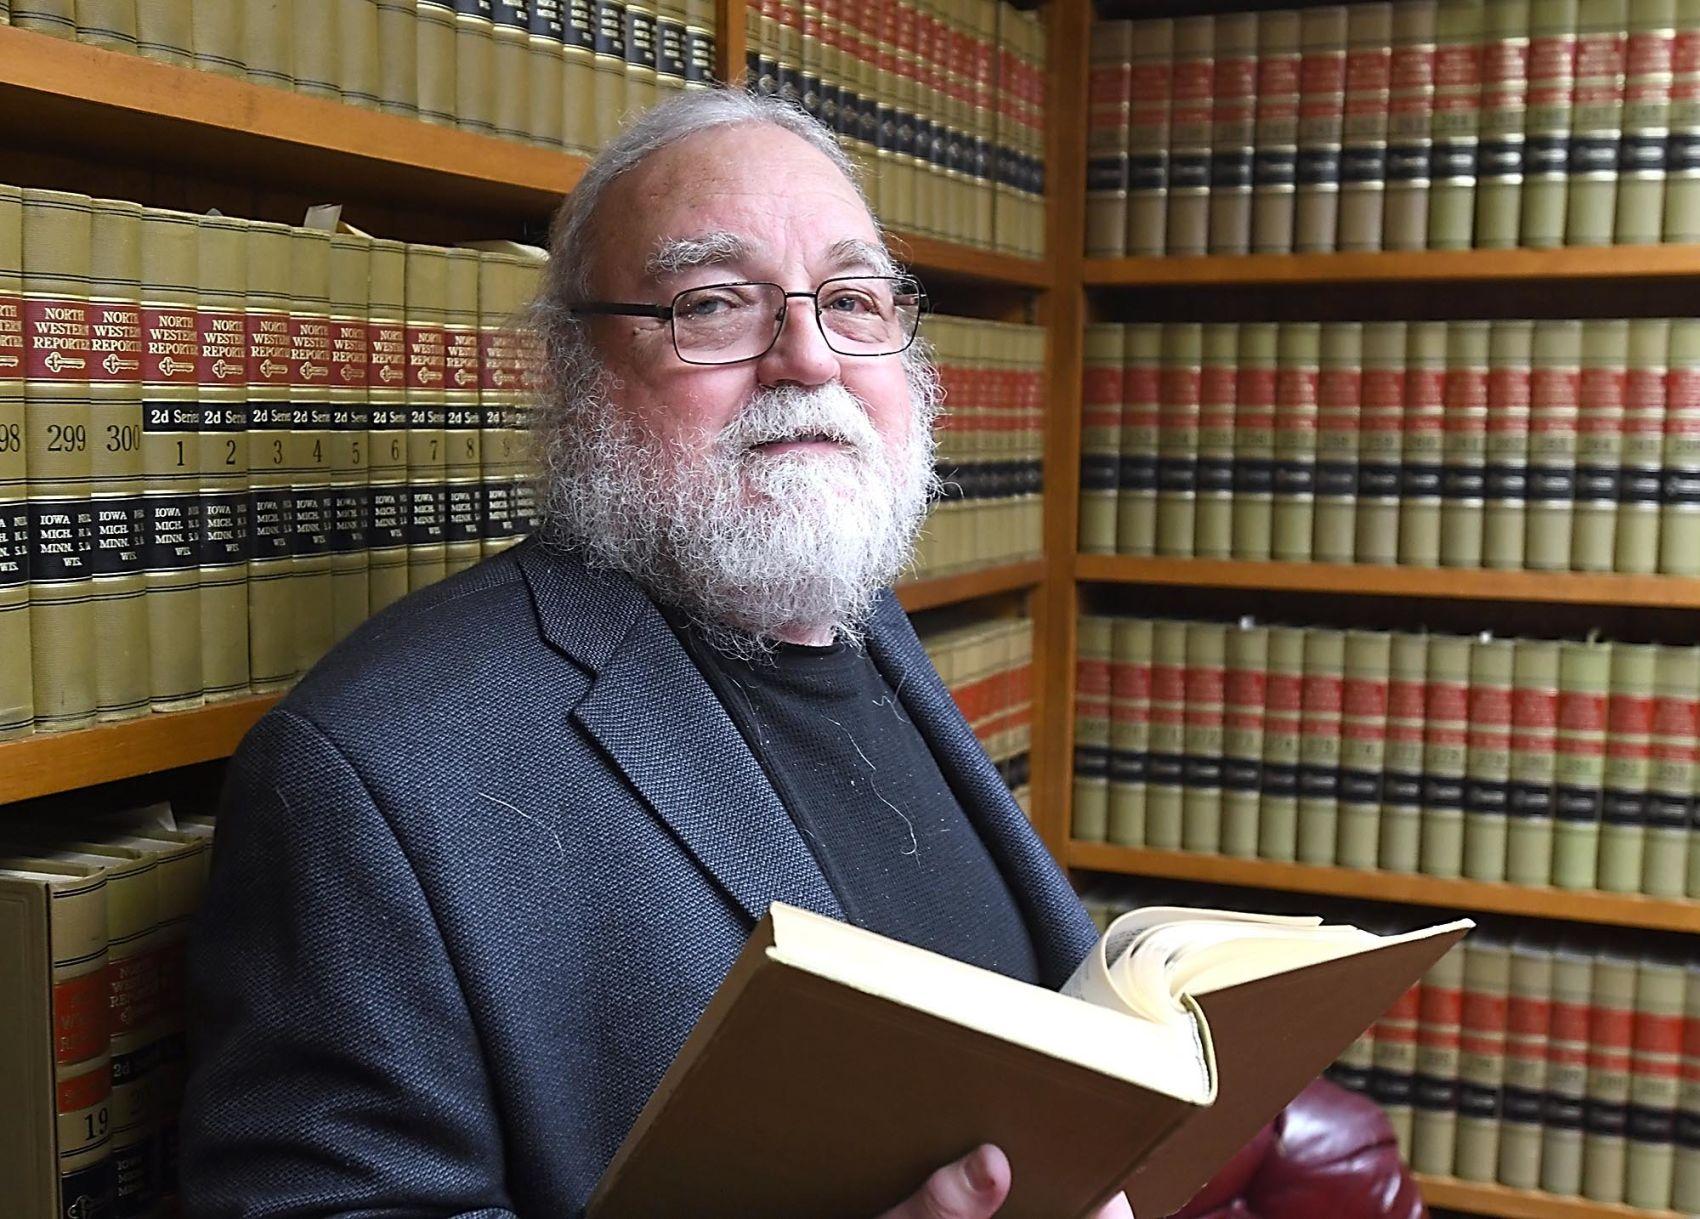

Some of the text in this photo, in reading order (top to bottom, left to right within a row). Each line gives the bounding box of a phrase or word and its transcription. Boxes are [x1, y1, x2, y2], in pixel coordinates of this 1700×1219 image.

[44, 307, 85, 321] NORTH
[102, 311, 139, 324] NORTH
[34, 321, 89, 335] WESTERN
[159, 315, 194, 328] NORTH
[212, 319, 243, 332] NORTH
[151, 409, 169, 424] 2d
[204, 410, 221, 424] 2d
[252, 409, 268, 422] 2d
[293, 410, 308, 423] 2d
[334, 411, 348, 423] 2d
[373, 411, 387, 423] 2d
[411, 411, 425, 423] 2d
[448, 412, 461, 424] 2d
[487, 411, 499, 423] 2d
[47, 425, 86, 451] 299
[106, 425, 140, 451] 300
[176, 440, 185, 466] 1
[226, 440, 236, 465] 2
[274, 439, 283, 464] 3
[312, 439, 322, 462] 4
[352, 442, 360, 464] 5
[391, 439, 399, 461] 6
[429, 440, 438, 460] 7
[466, 438, 475, 459] 8
[40, 515, 71, 525] IOWA
[99, 511, 127, 521] IOWA
[155, 508, 181, 518] IOWA
[113, 1064, 130, 1077] 2d
[84, 1107, 108, 1141] 19
